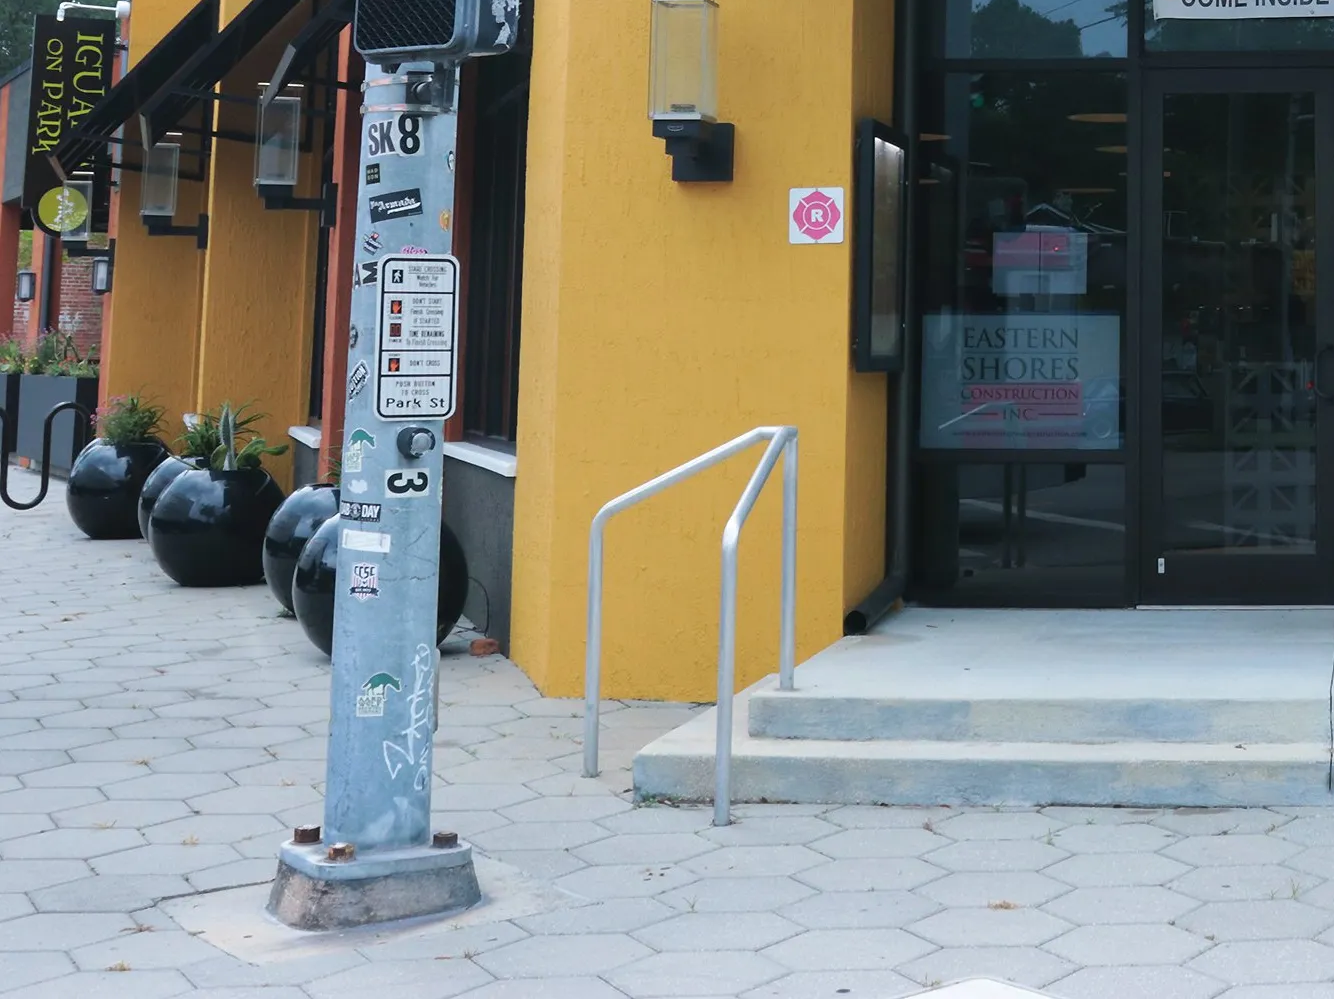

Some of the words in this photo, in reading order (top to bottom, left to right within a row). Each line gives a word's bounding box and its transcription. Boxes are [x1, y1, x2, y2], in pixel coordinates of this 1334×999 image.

[46, 38, 64, 72] ON
[67, 32, 105, 168] IGUA
[368, 114, 421, 156] SK8
[811, 209, 824, 222] R
[963, 327, 1079, 349] EASTERN
[961, 356, 1079, 381] SHORES
[386, 398, 421, 408] Park
[430, 398, 445, 408] St
[960, 387, 1079, 401] CONSTRUCTION
[362, 505, 380, 518] DAY
